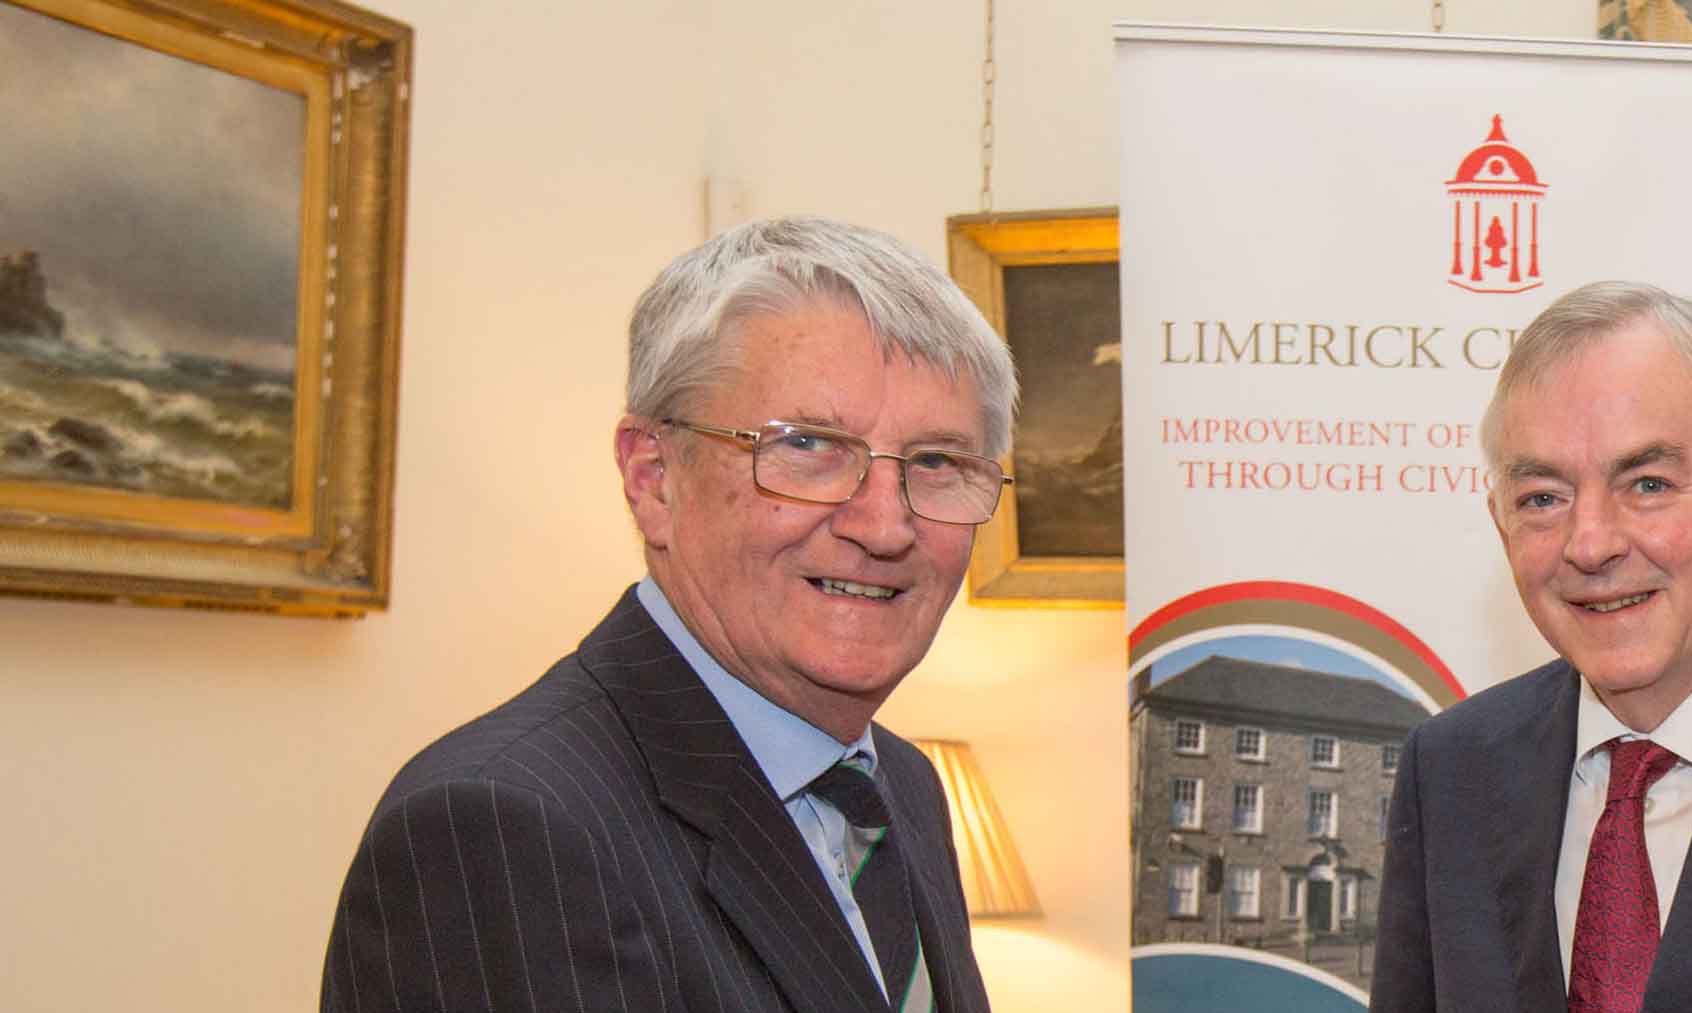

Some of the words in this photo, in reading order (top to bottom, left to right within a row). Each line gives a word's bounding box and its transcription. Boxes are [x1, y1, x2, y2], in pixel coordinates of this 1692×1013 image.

[1160, 319, 1446, 369] LIMERICK
[1160, 417, 1417, 448] IMPROVEMENT
[1426, 422, 1472, 449] OF
[1178, 460, 1384, 492] THROUGH
